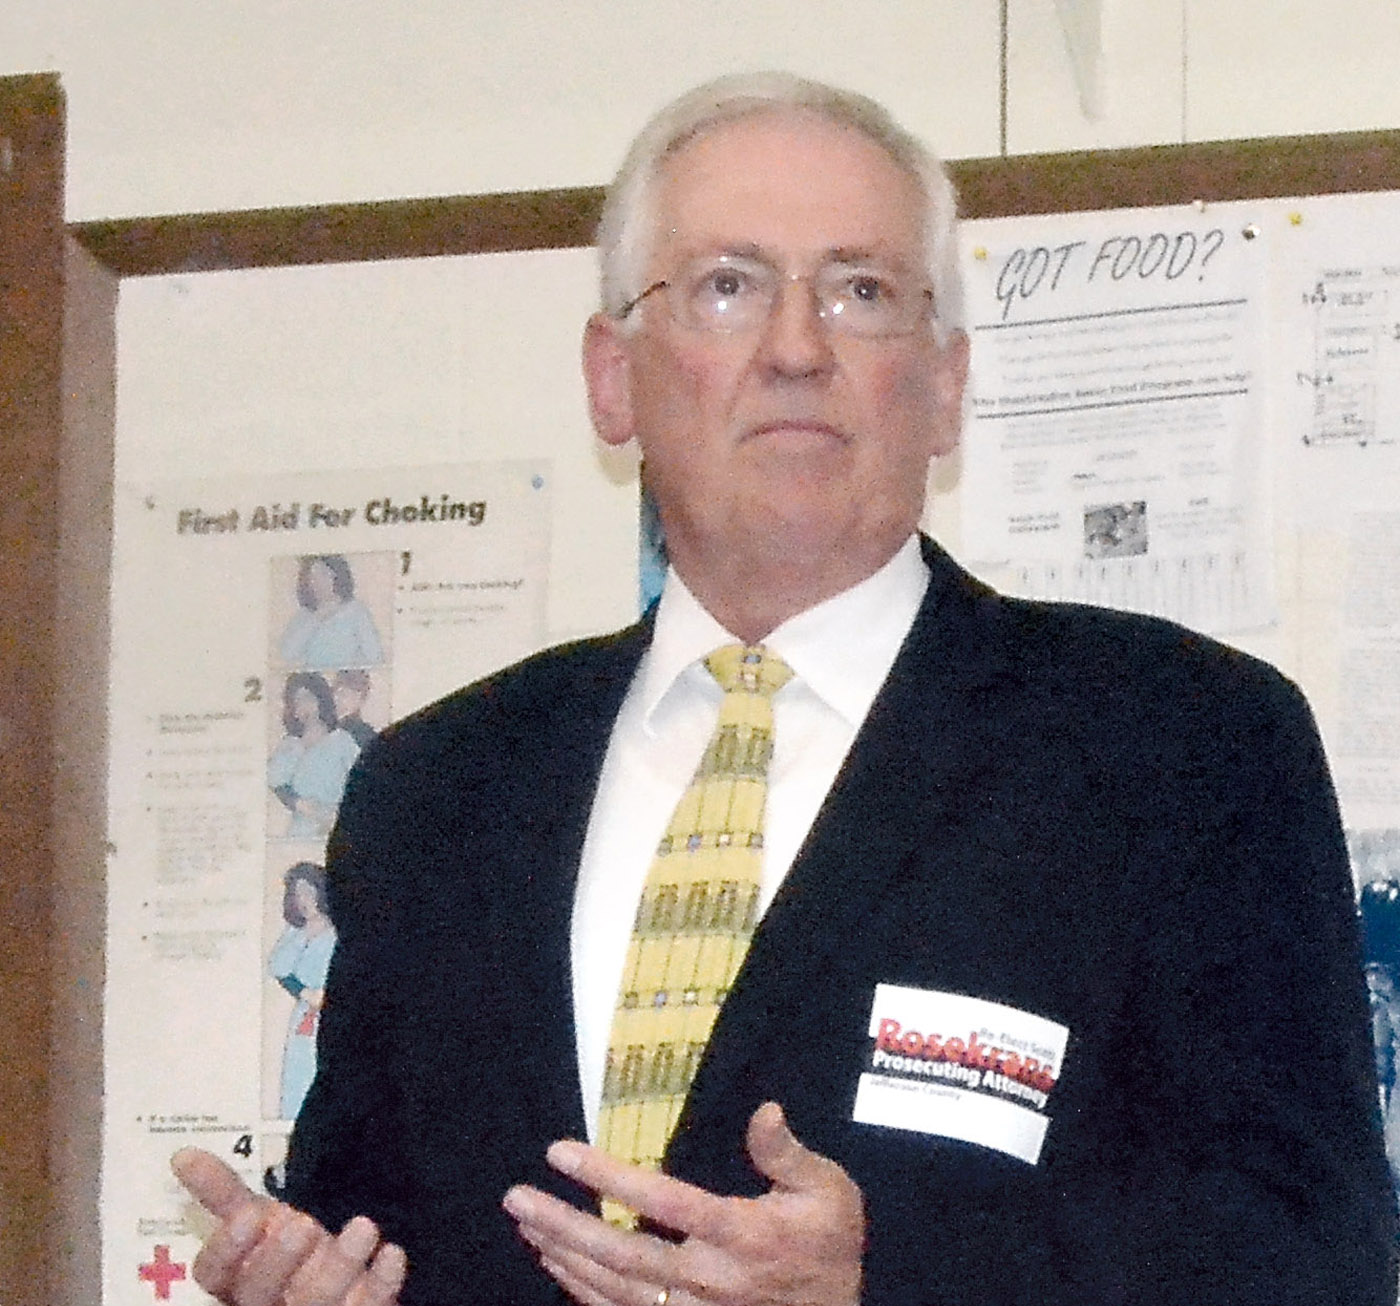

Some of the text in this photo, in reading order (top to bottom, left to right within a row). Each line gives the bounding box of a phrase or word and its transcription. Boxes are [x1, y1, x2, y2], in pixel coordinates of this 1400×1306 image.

[996, 229, 1225, 320] GOT FOOD?
[177, 494, 487, 536] First Aid For Choking
[401, 551, 411, 575] 1
[244, 677, 263, 702] 2
[876, 1018, 1057, 1094] Rosekrans
[873, 1050, 1049, 1110] Prosecuting Attorney
[233, 1135, 253, 1158] 4
